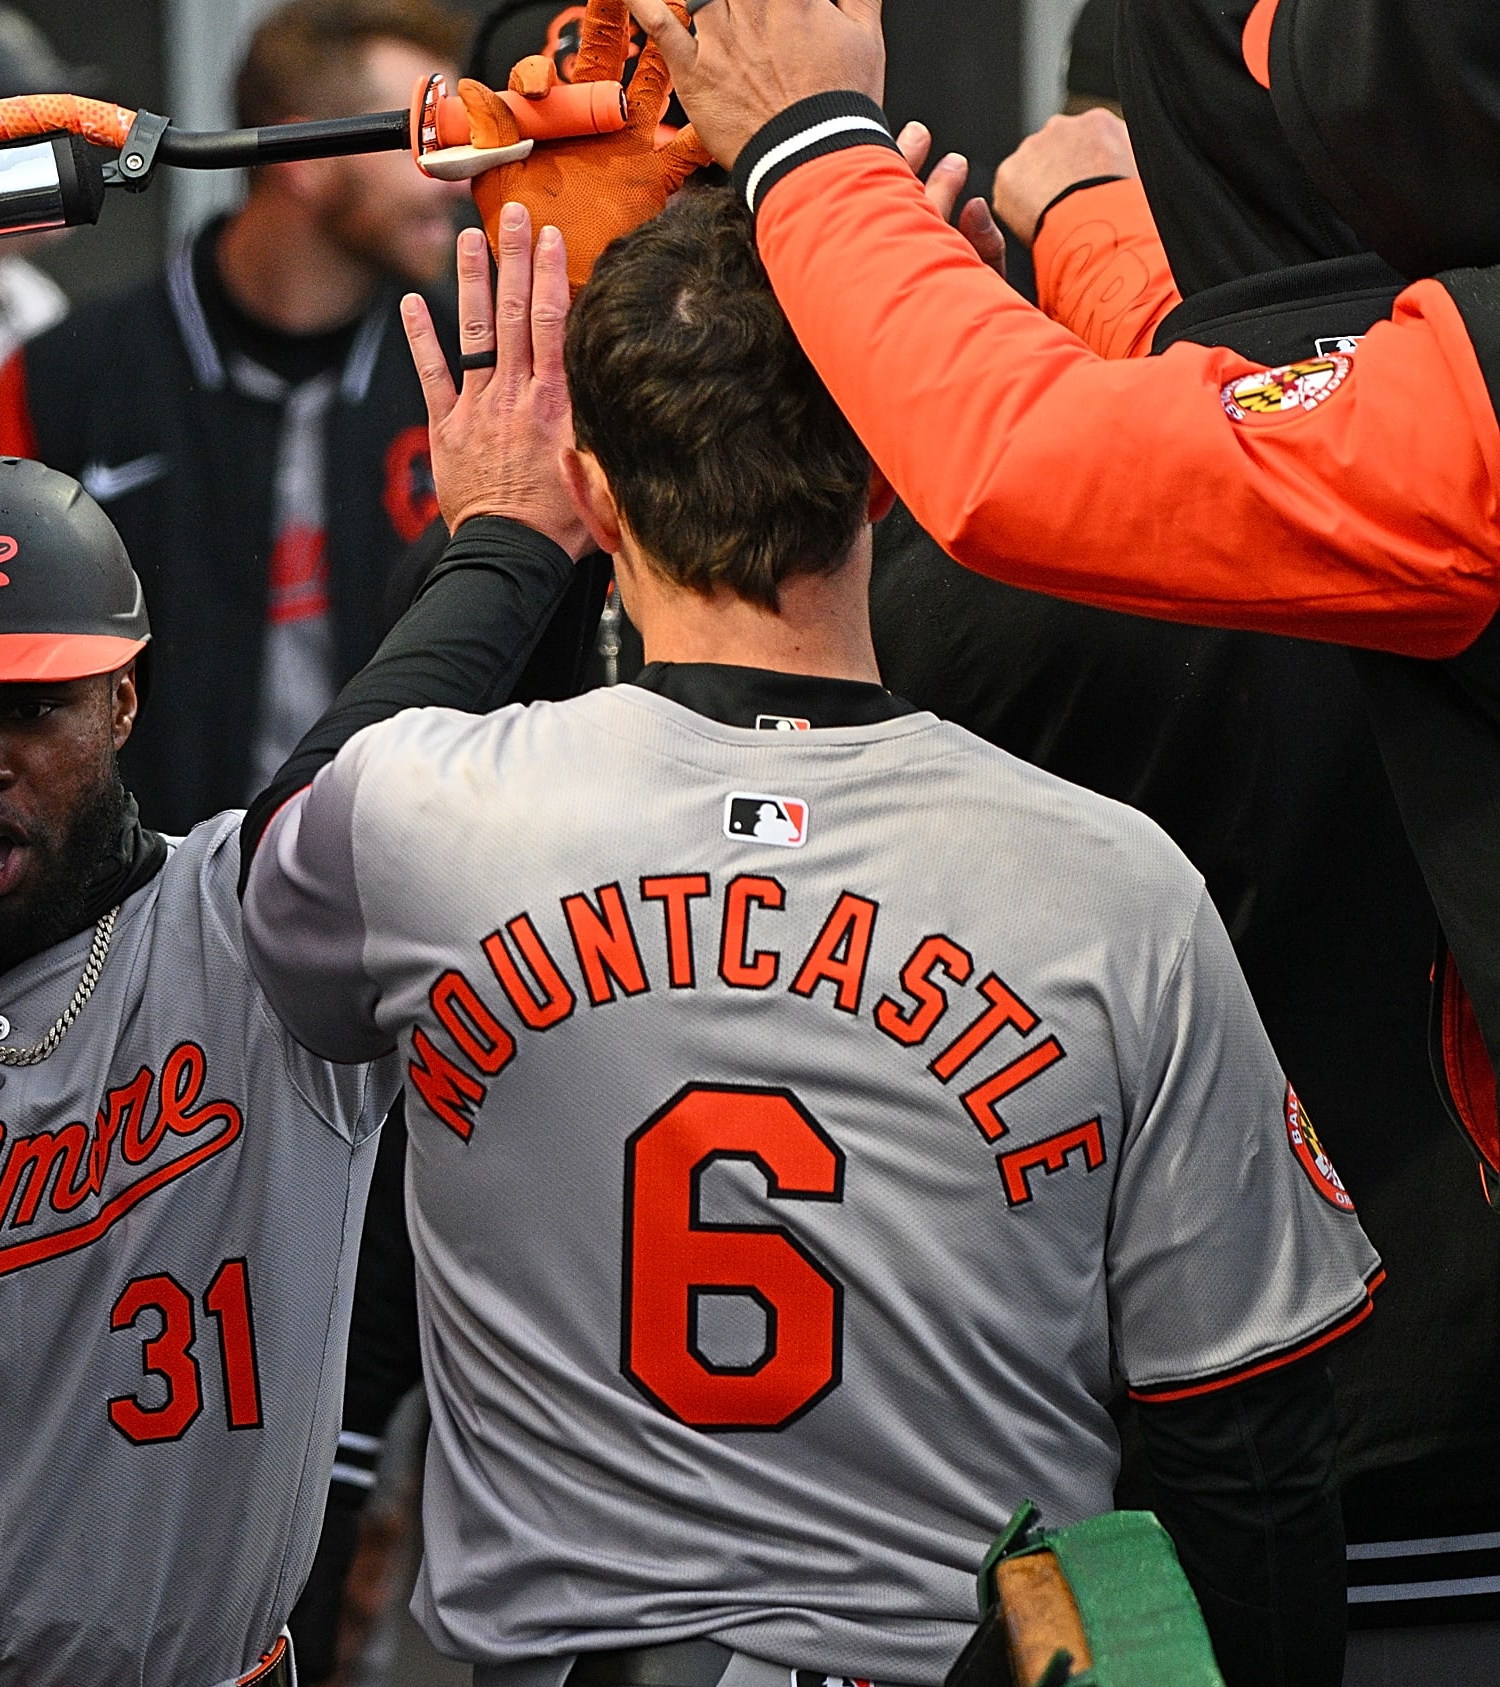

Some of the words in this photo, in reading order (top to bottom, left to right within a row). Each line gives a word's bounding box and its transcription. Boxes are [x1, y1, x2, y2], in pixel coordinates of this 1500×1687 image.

[407, 872, 1107, 1208] MOUNTCASTLE
[106, 1256, 264, 1446] 31
[620, 1080, 845, 1432] 6
